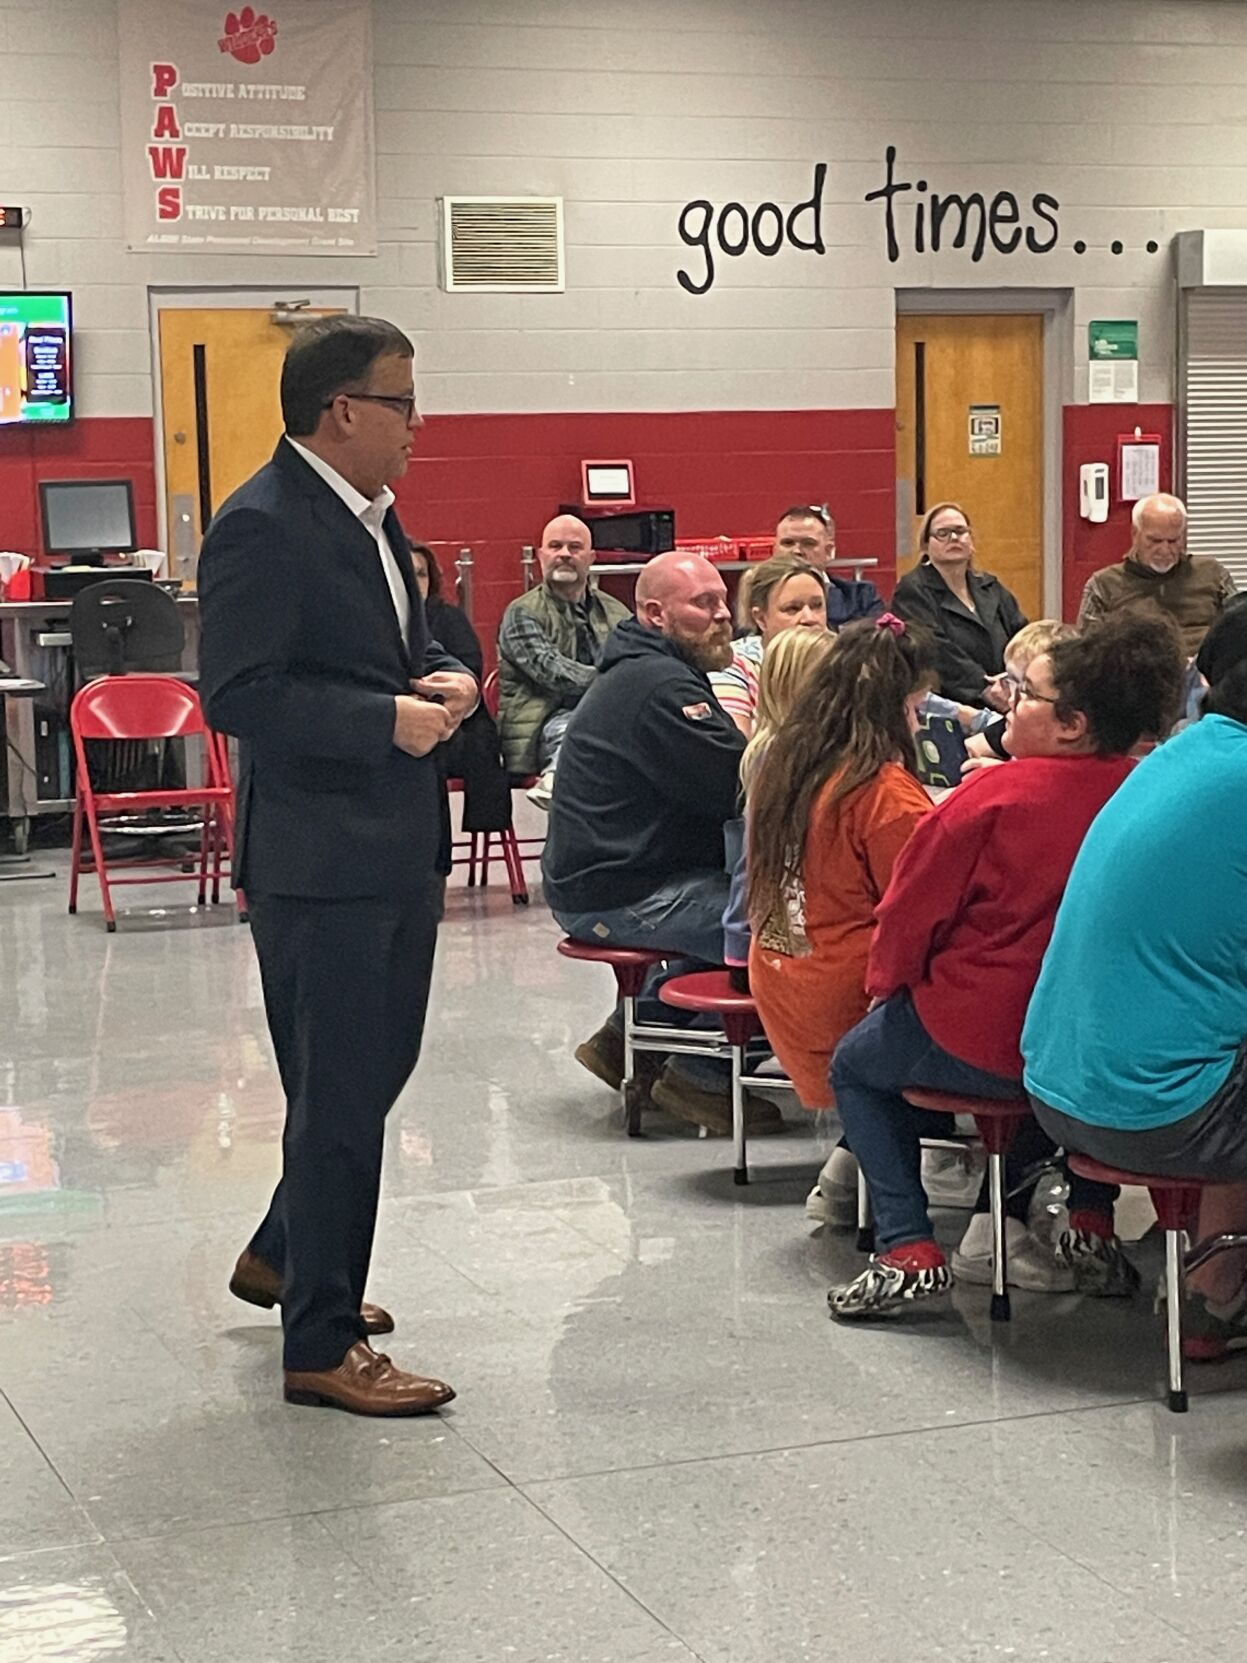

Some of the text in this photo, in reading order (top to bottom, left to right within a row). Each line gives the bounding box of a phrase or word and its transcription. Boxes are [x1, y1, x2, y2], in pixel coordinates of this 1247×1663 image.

[238, 83, 306, 100] ATTITUDE
[214, 165, 271, 181] RESPECT
[230, 205, 255, 221] FOR
[258, 206, 324, 222] PERSONAL
[327, 207, 360, 223] BEST
[677, 163, 827, 294] good
